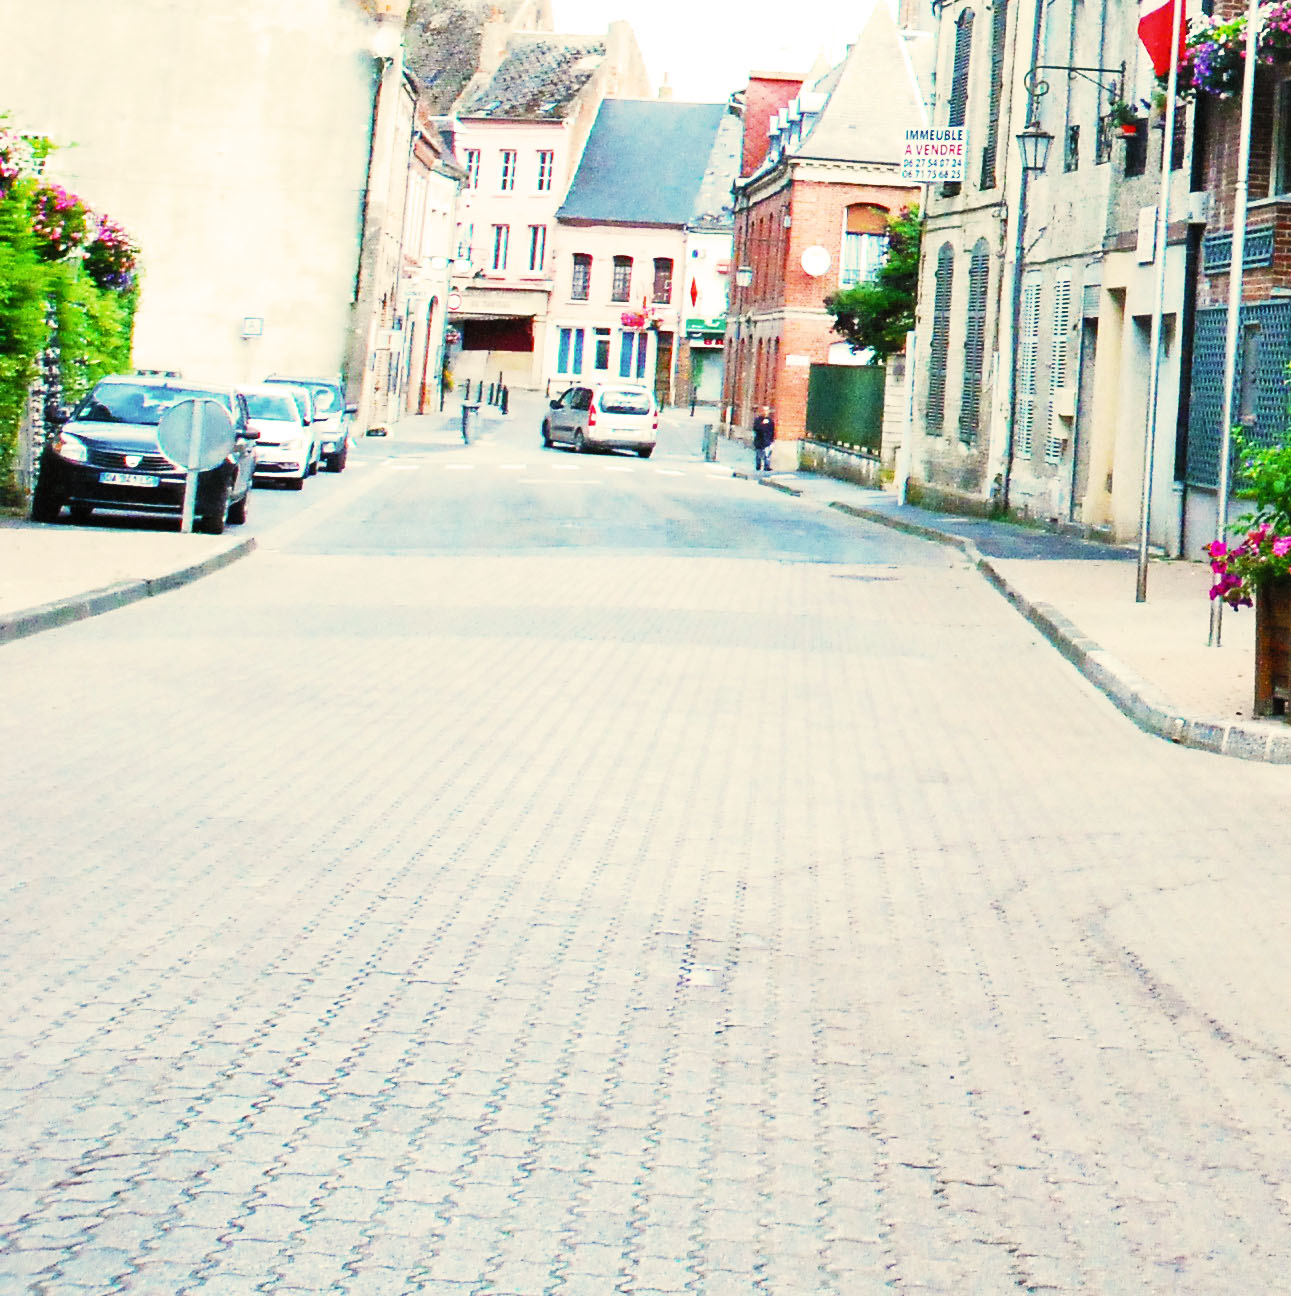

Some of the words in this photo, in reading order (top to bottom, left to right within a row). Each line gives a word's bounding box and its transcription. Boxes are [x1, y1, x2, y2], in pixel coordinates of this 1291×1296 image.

[905, 129, 963, 141] IMMEUBLE
[904, 144, 913, 156] A
[916, 144, 963, 156] VENDRE
